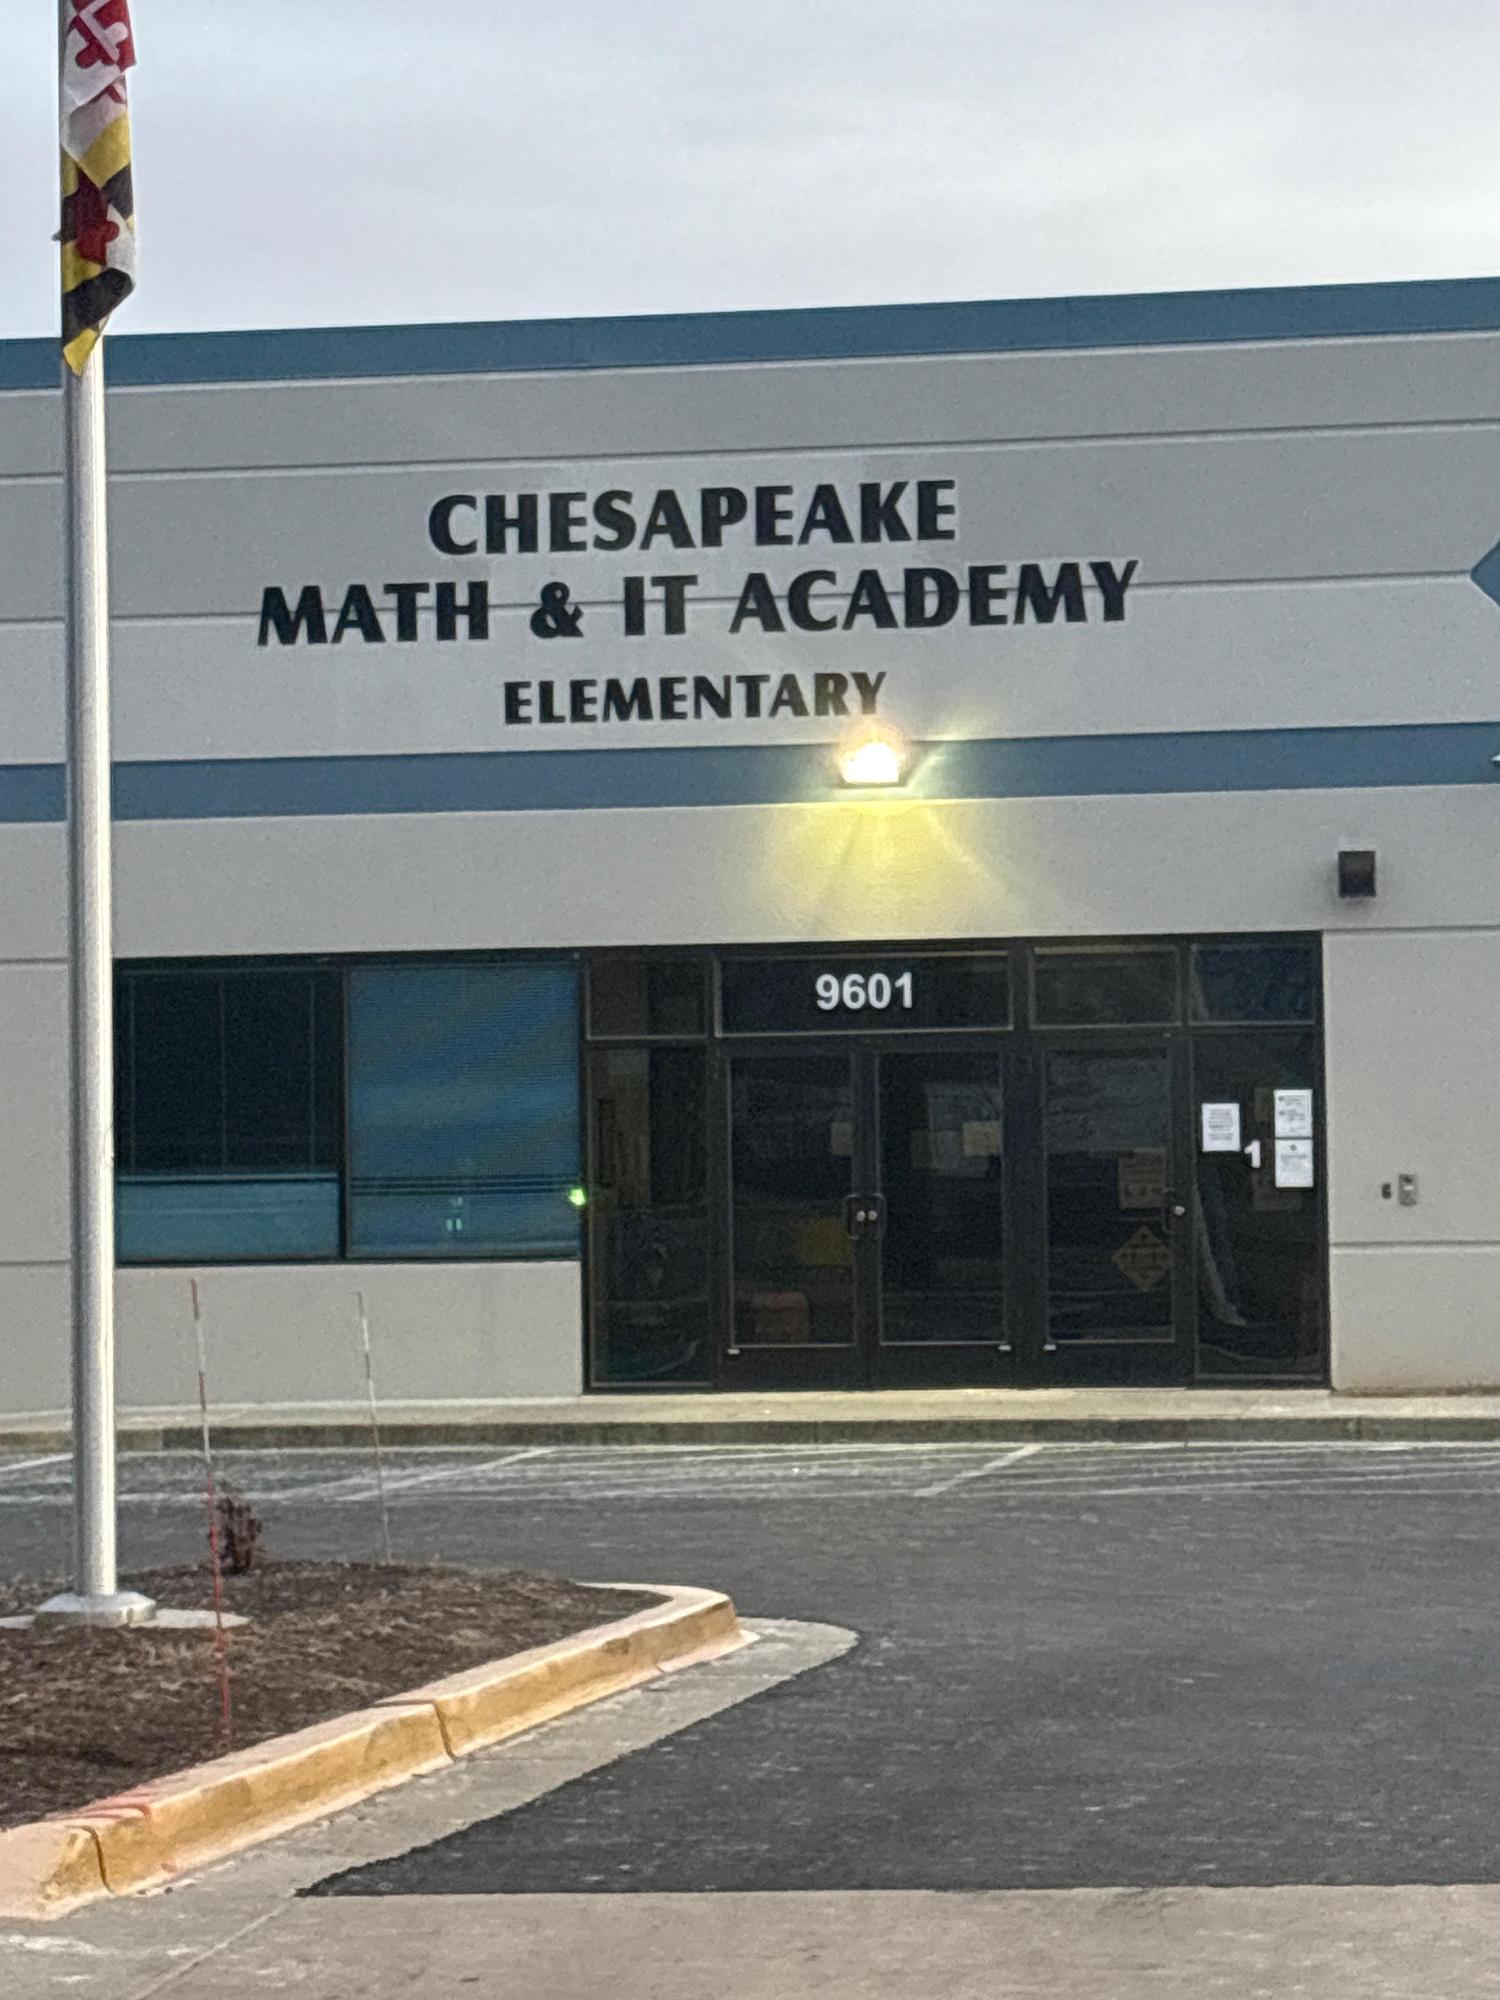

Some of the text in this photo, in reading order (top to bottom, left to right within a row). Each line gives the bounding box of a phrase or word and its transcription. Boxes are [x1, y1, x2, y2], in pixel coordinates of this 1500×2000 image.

[428, 479, 956, 556] CHESAPEAKE
[257, 559, 1138, 646] MATH & IT ACADEMY
[504, 672, 886, 725] ELEMENTARY
[815, 972, 913, 1011] 9601
[1244, 1140, 1262, 1169] 1
